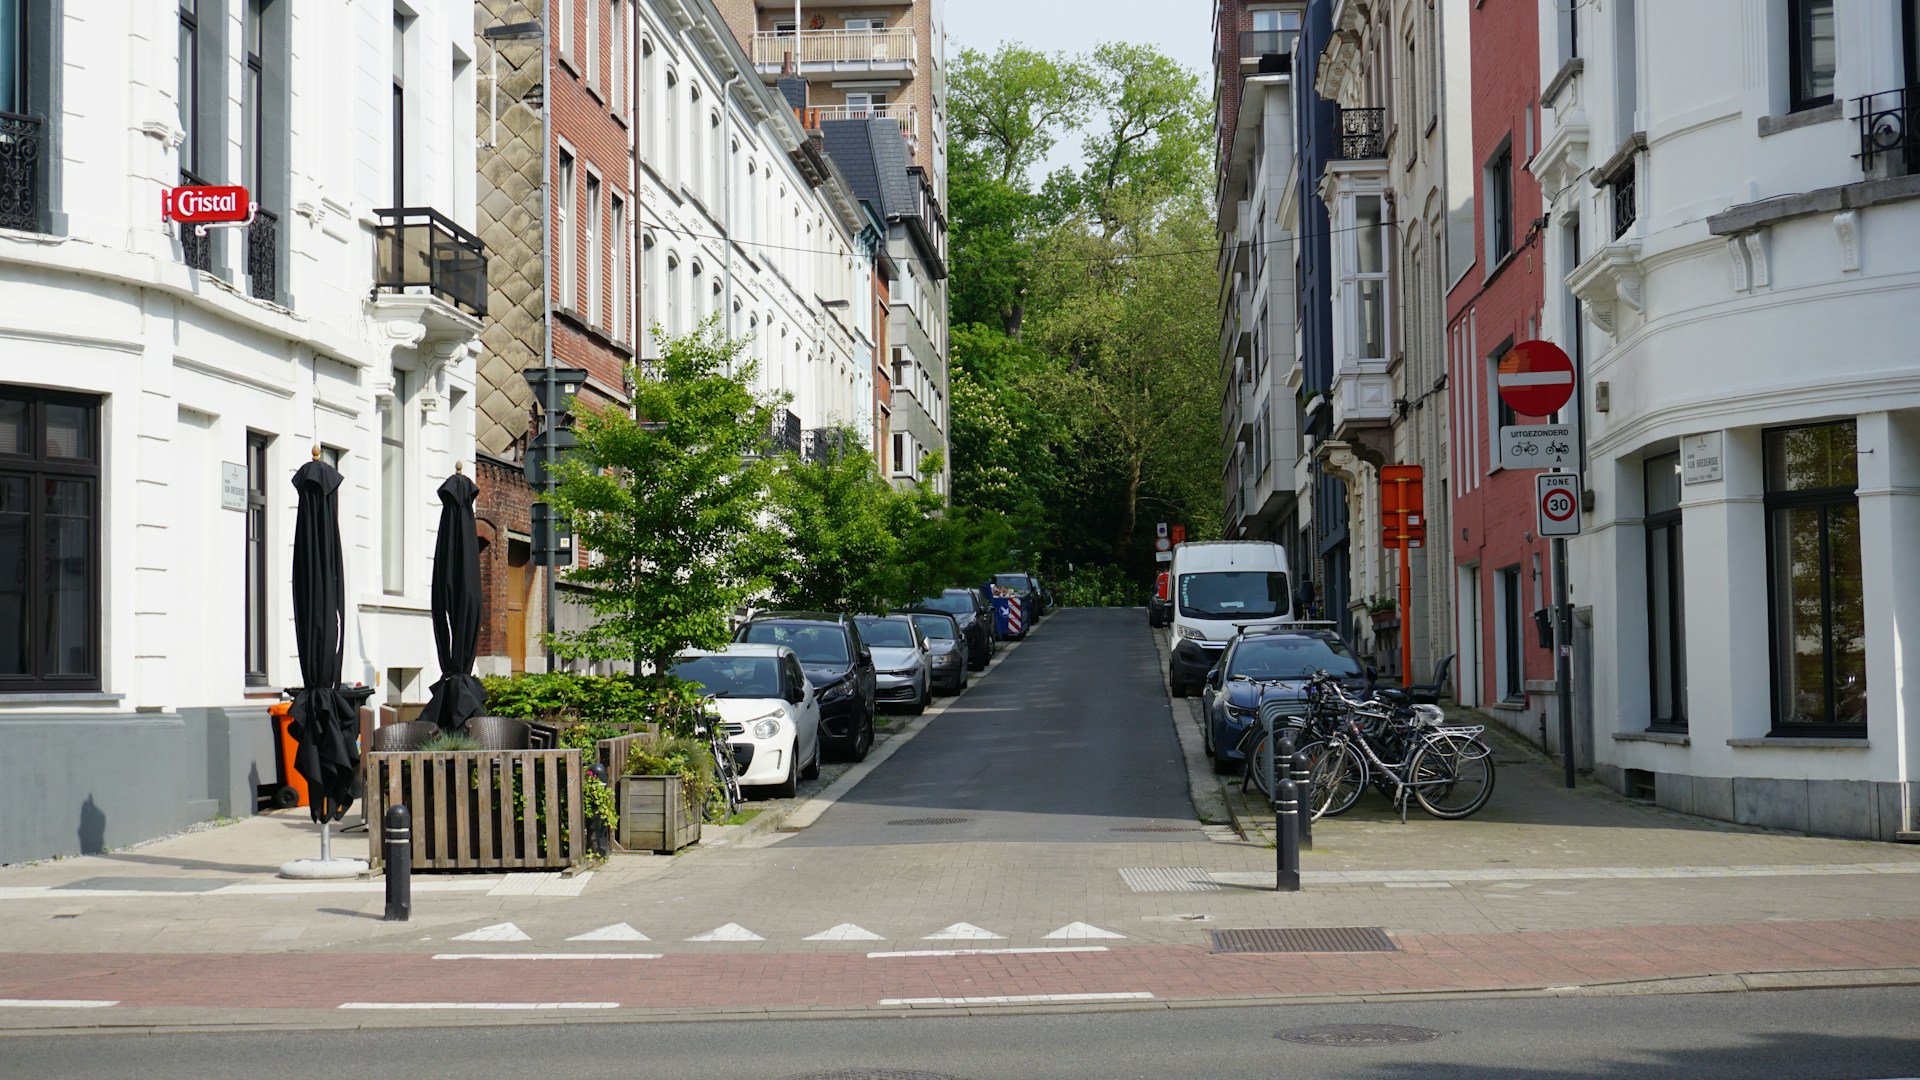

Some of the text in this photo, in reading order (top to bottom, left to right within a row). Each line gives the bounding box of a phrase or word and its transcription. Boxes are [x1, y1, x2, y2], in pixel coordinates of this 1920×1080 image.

[178, 191, 236, 216] Cristal
[1510, 428, 1569, 438] UITGEZONDERD
[1547, 478, 1570, 486] ZONE
[1550, 499, 1568, 511] 30
